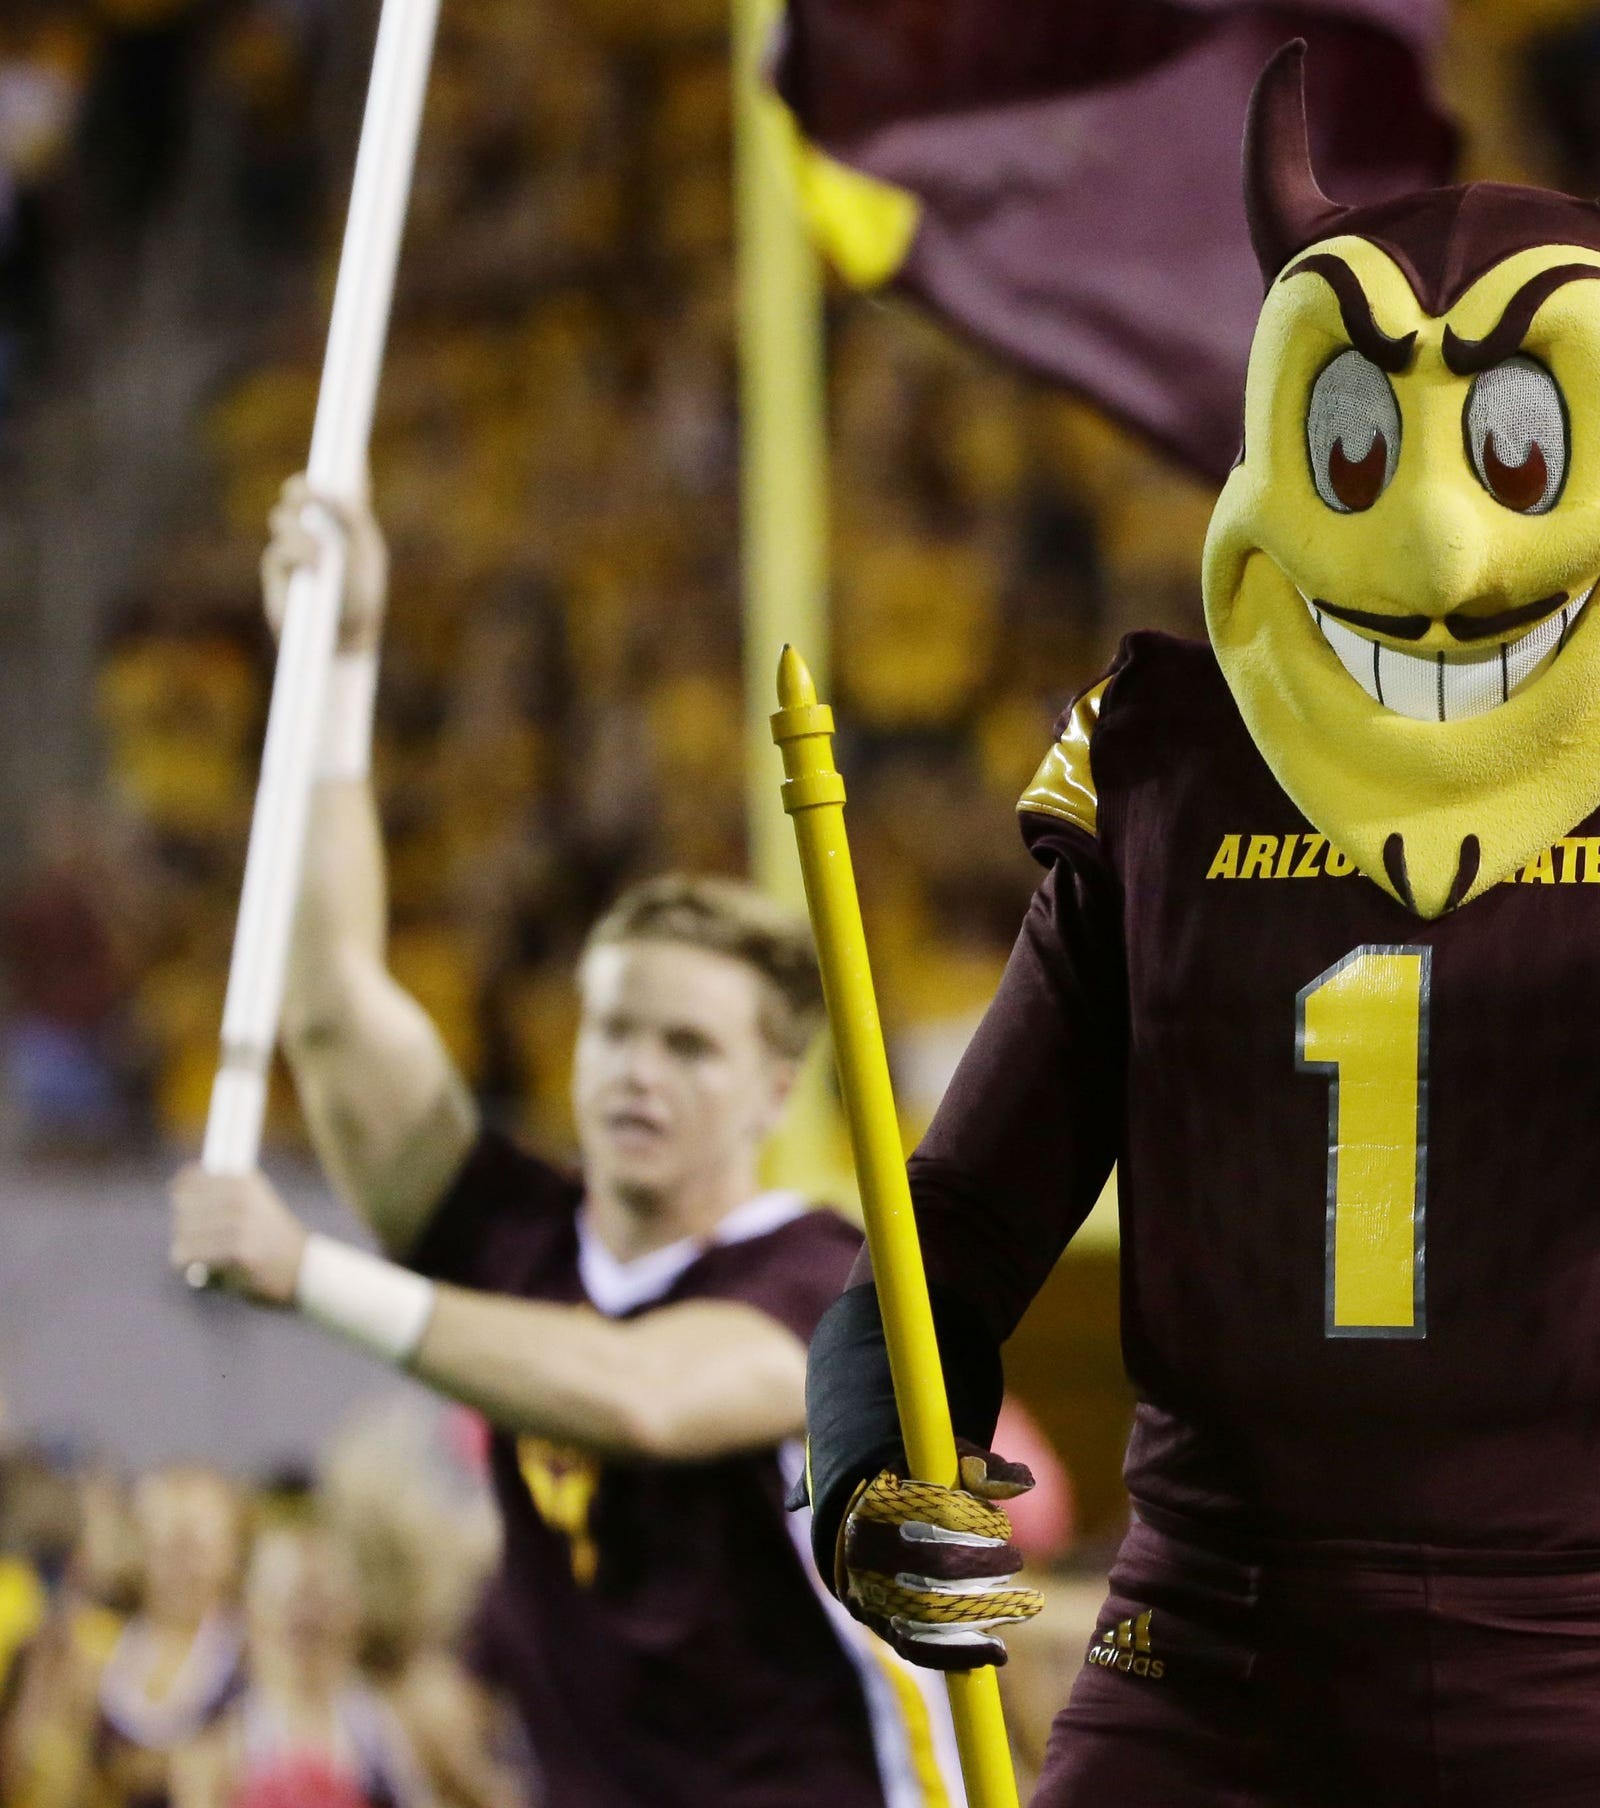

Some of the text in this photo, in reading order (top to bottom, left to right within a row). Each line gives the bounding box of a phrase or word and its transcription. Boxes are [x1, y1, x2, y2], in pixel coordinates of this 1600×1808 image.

[1206, 834, 1367, 879] ARIZO
[1295, 944, 1432, 1340] 1
[1088, 1645, 1165, 1679] adidas
